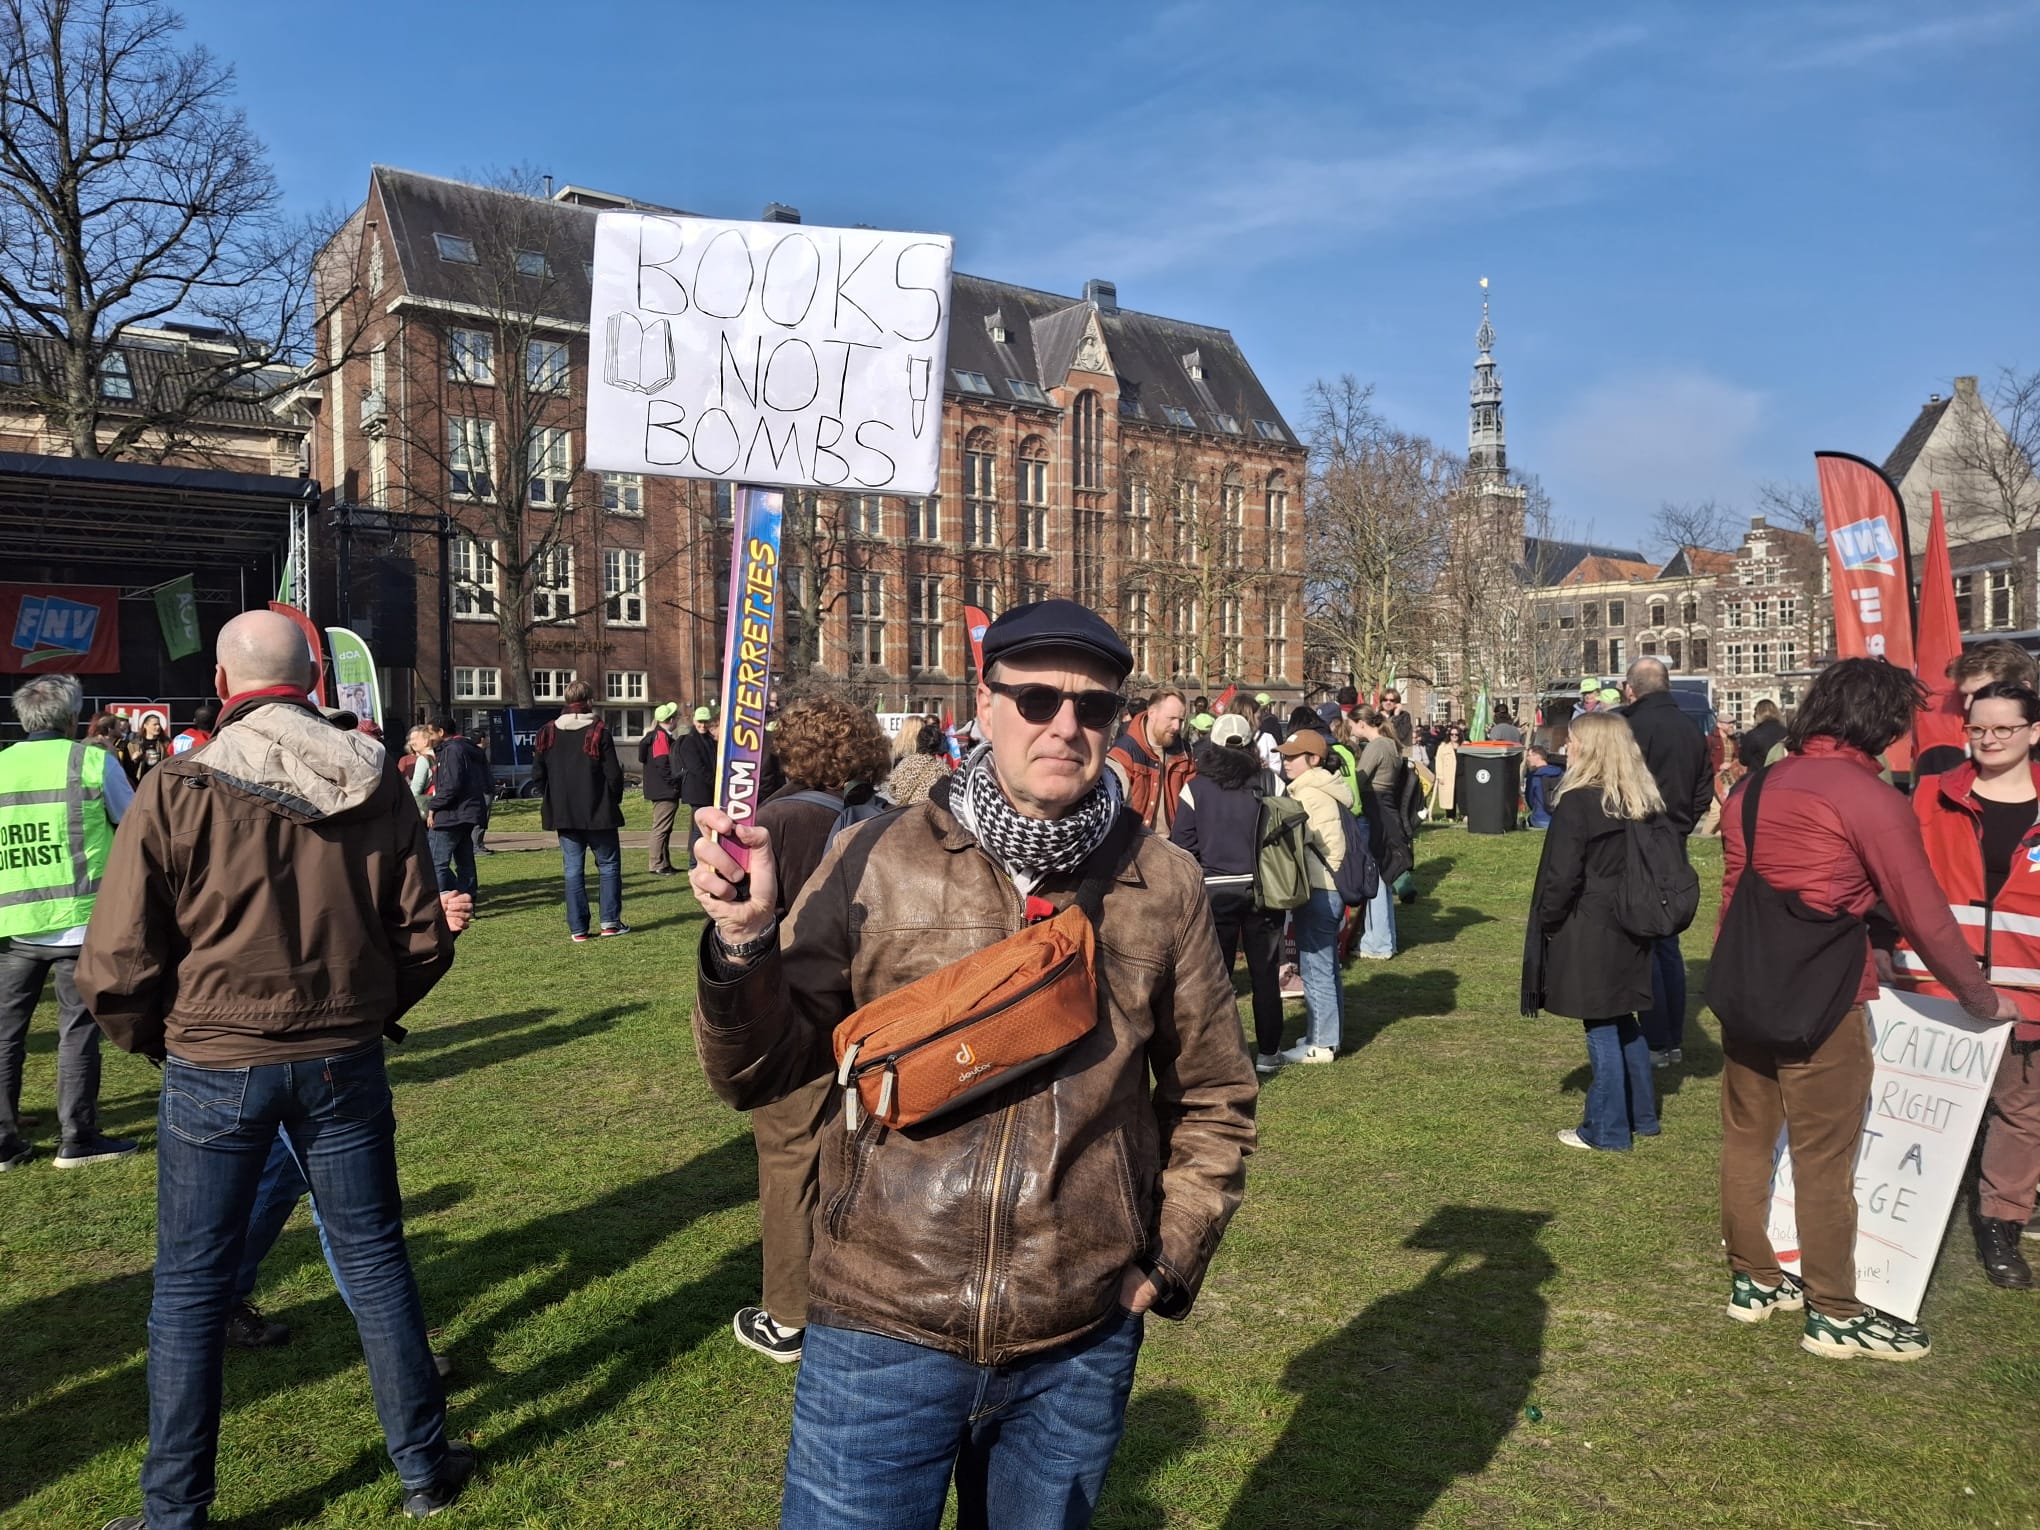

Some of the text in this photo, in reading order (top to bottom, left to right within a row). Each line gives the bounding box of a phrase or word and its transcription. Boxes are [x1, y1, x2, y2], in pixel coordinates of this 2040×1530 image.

[637, 214, 946, 342] BOOKS
[719, 329, 883, 419] NOT
[644, 399, 896, 488] BOMBS
[18, 607, 97, 639] FNV
[732, 537, 777, 751] STERRETJES
[0, 822, 52, 846] ORDE
[1876, 1080, 1963, 1130] RIGHT
[1898, 1142, 1922, 1177] A
